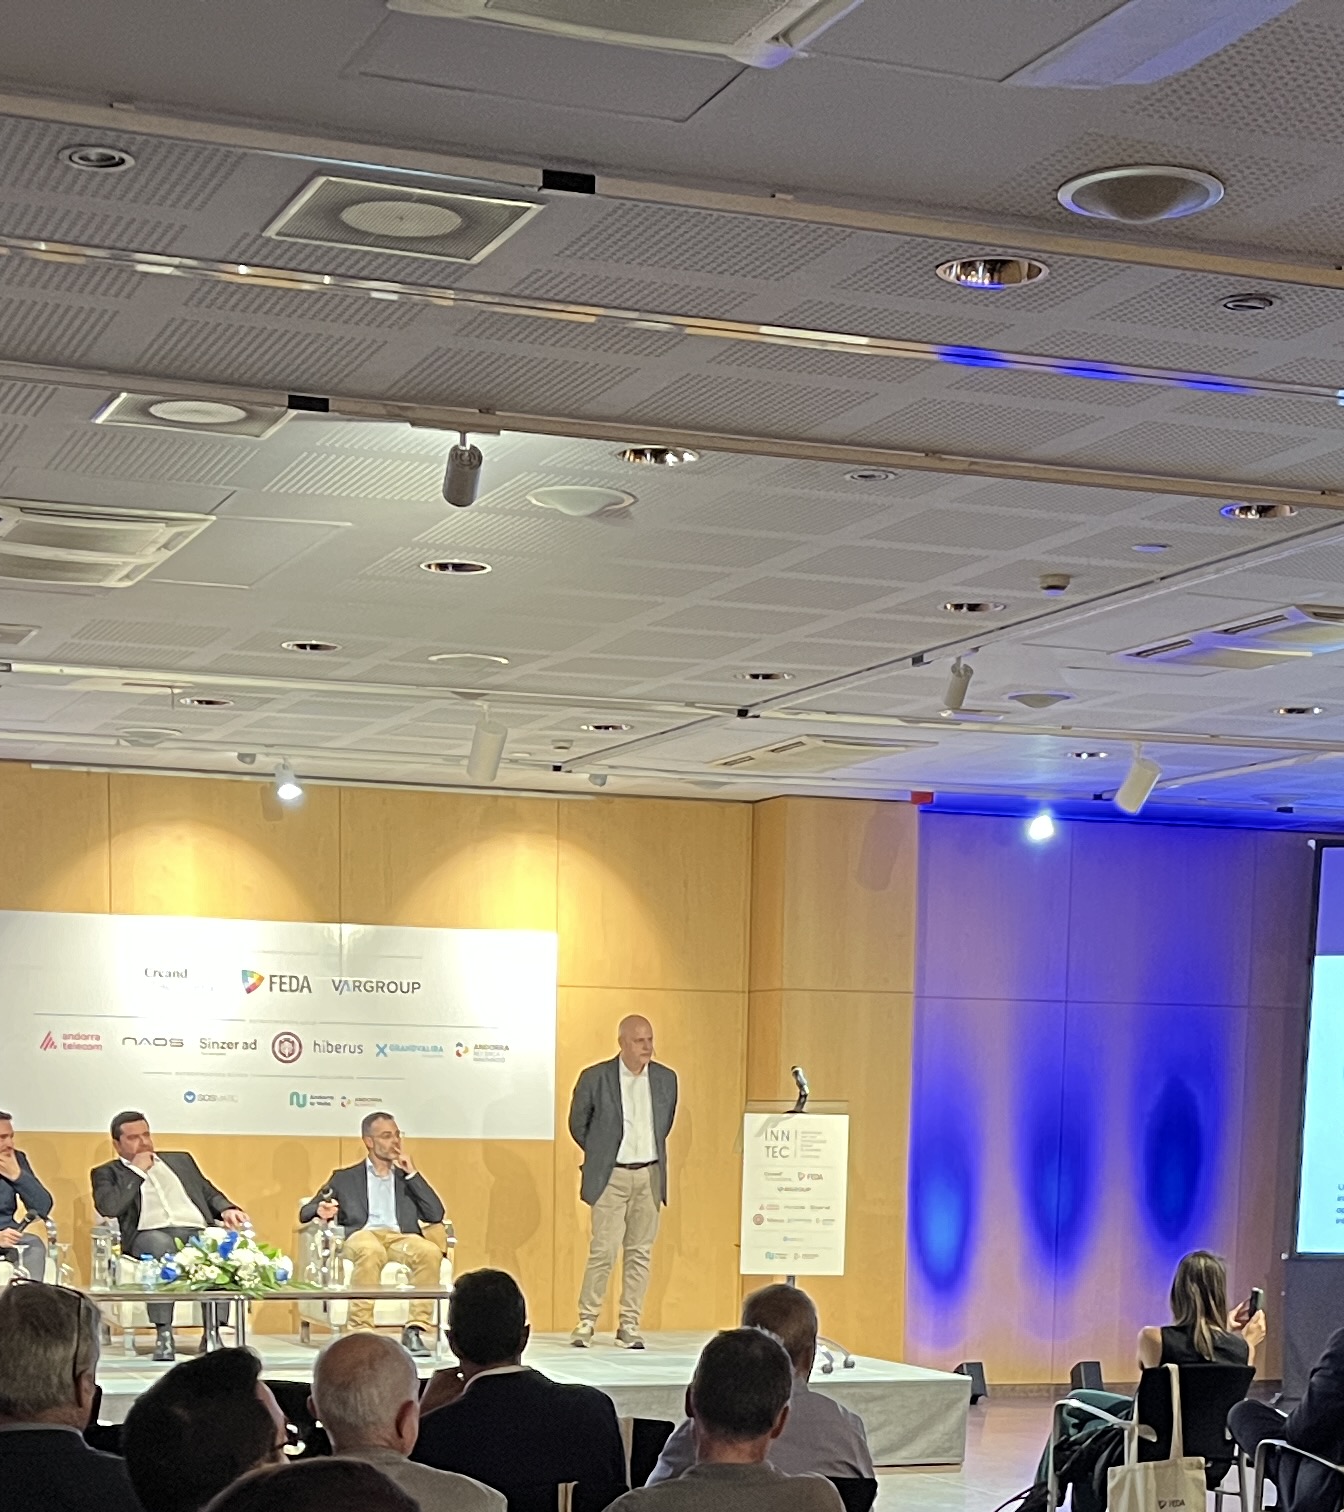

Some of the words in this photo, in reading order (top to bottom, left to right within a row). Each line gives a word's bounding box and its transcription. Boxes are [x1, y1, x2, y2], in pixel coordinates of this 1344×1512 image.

[269, 974, 313, 994] FEDA
[331, 978, 422, 995] VARGROUP
[62, 1032, 101, 1042] andorra
[312, 1040, 364, 1055] hiberus
[764, 1129, 790, 1141] INN
[764, 1145, 790, 1158] TEC
